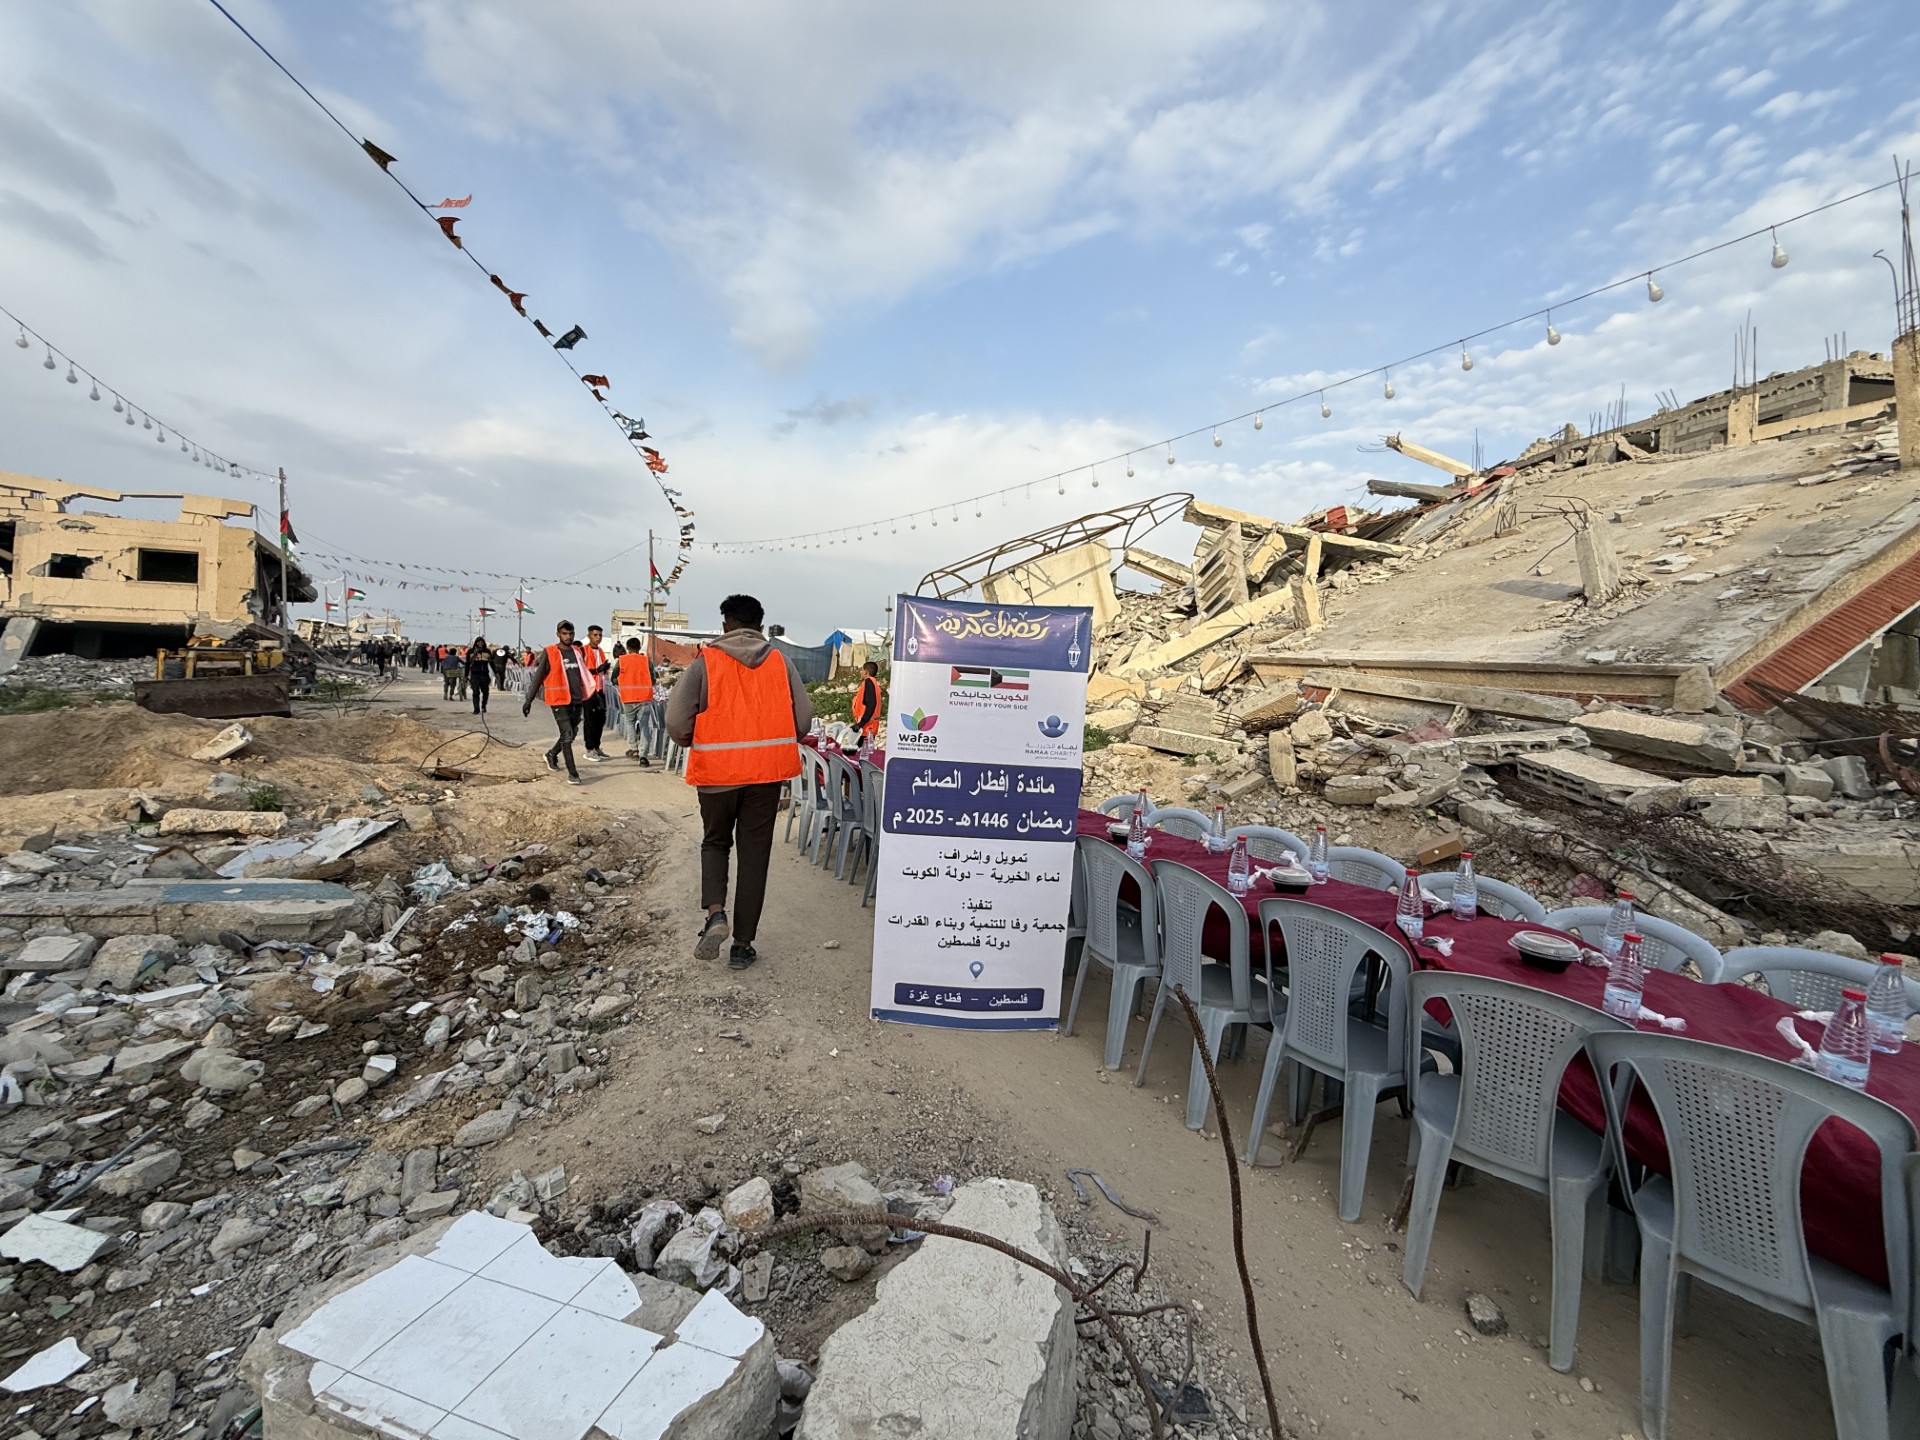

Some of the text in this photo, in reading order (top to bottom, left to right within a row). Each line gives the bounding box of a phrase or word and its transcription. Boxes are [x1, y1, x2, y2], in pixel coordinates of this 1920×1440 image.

[982, 610, 1052, 641] رمضان
[949, 690, 1029, 702] الكويت بجانبكم
[898, 732, 938, 745] wafaa
[1025, 742, 1056, 750] الخيرية
[911, 768, 1056, 798] مائدة إفطار الصائم
[892, 810, 902, 830] م
[906, 807, 944, 825] 2025
[1016, 809, 1073, 835] رمضان
[938, 849, 1028, 865] تمويل وإشراف:
[902, 866, 939, 880] الكويت
[945, 867, 971, 882] دولة
[990, 867, 1030, 884] الخيرية
[1035, 871, 1060, 884] نماء
[961, 898, 993, 913] تنفيذ:
[887, 914, 1066, 934] جمعية وفا للتنمية وبناء القدرات
[937, 934, 1011, 949] دولة فلسطين
[908, 988, 930, 1003] غزة
[934, 991, 962, 1006] قطاع
[988, 992, 1028, 1007] فلسطين
